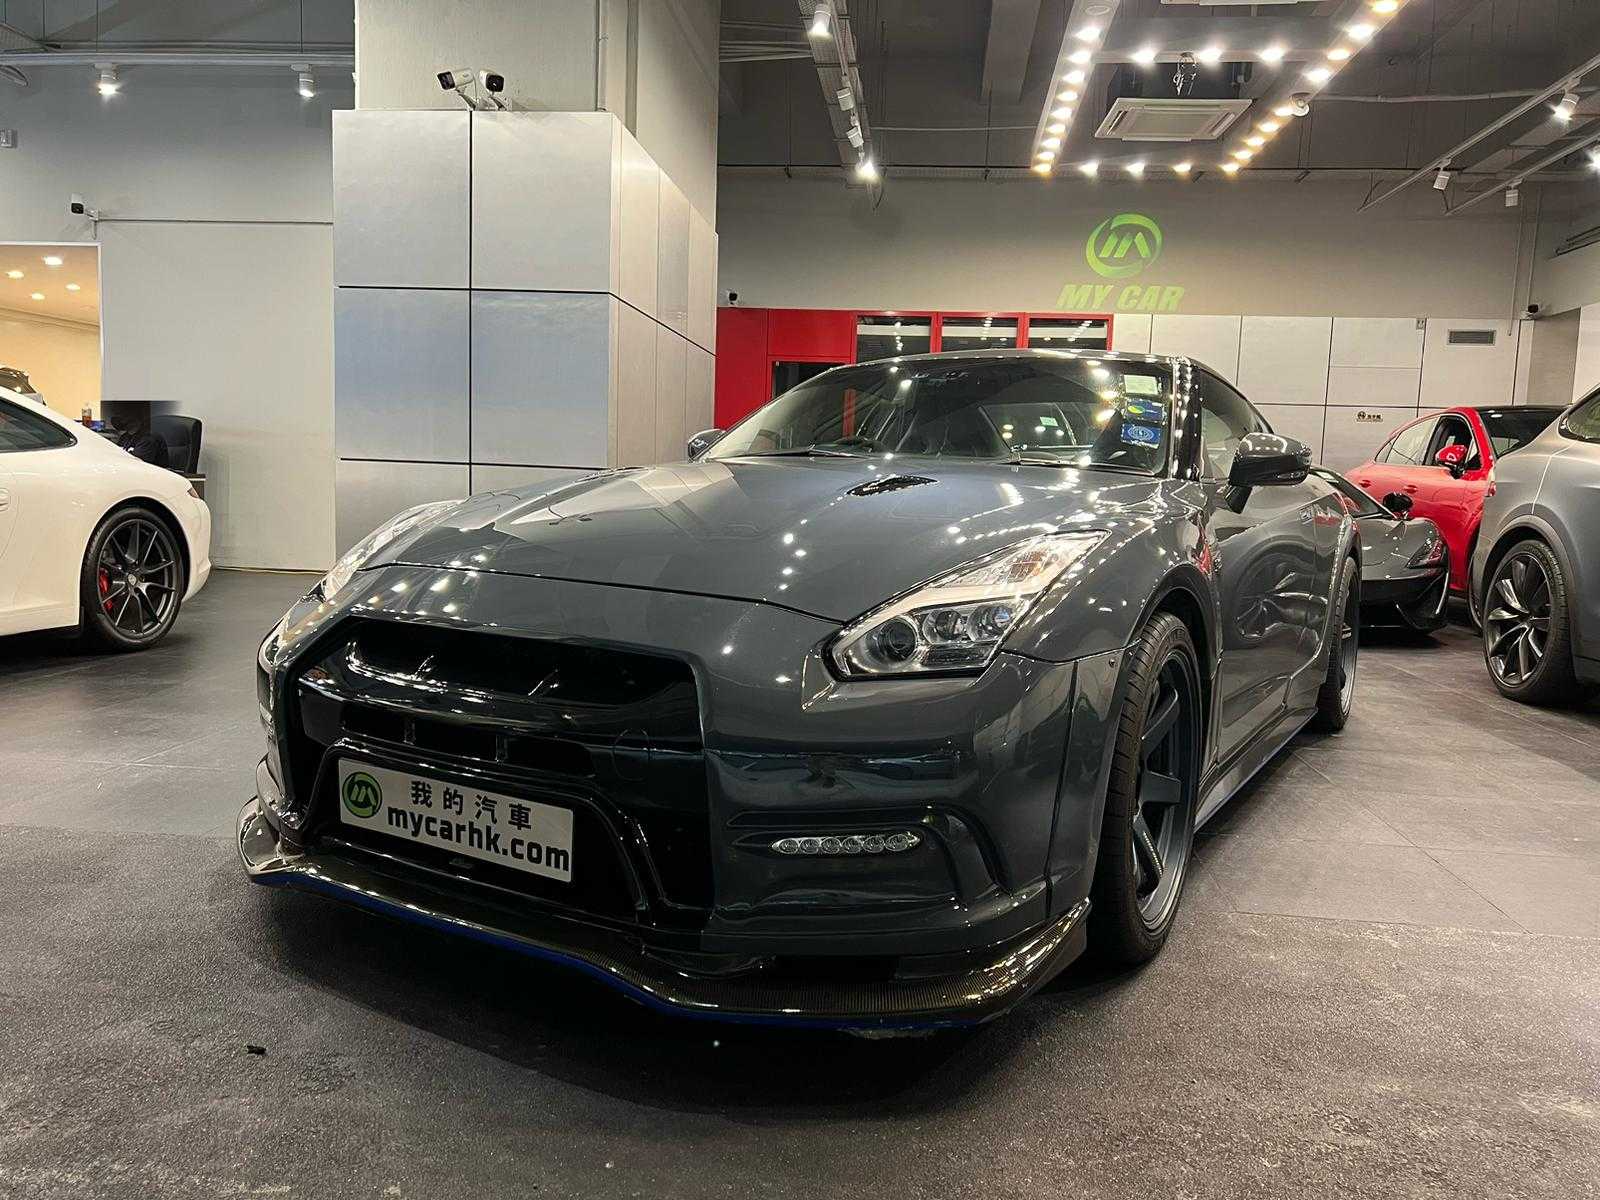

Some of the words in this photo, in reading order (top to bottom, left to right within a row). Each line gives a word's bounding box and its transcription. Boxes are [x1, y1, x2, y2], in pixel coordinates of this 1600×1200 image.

[1056, 285, 1114, 311] MY
[1116, 285, 1185, 312] CAR
[411, 780, 532, 830] 我的汽車
[387, 806, 570, 871] mycarhk.com
